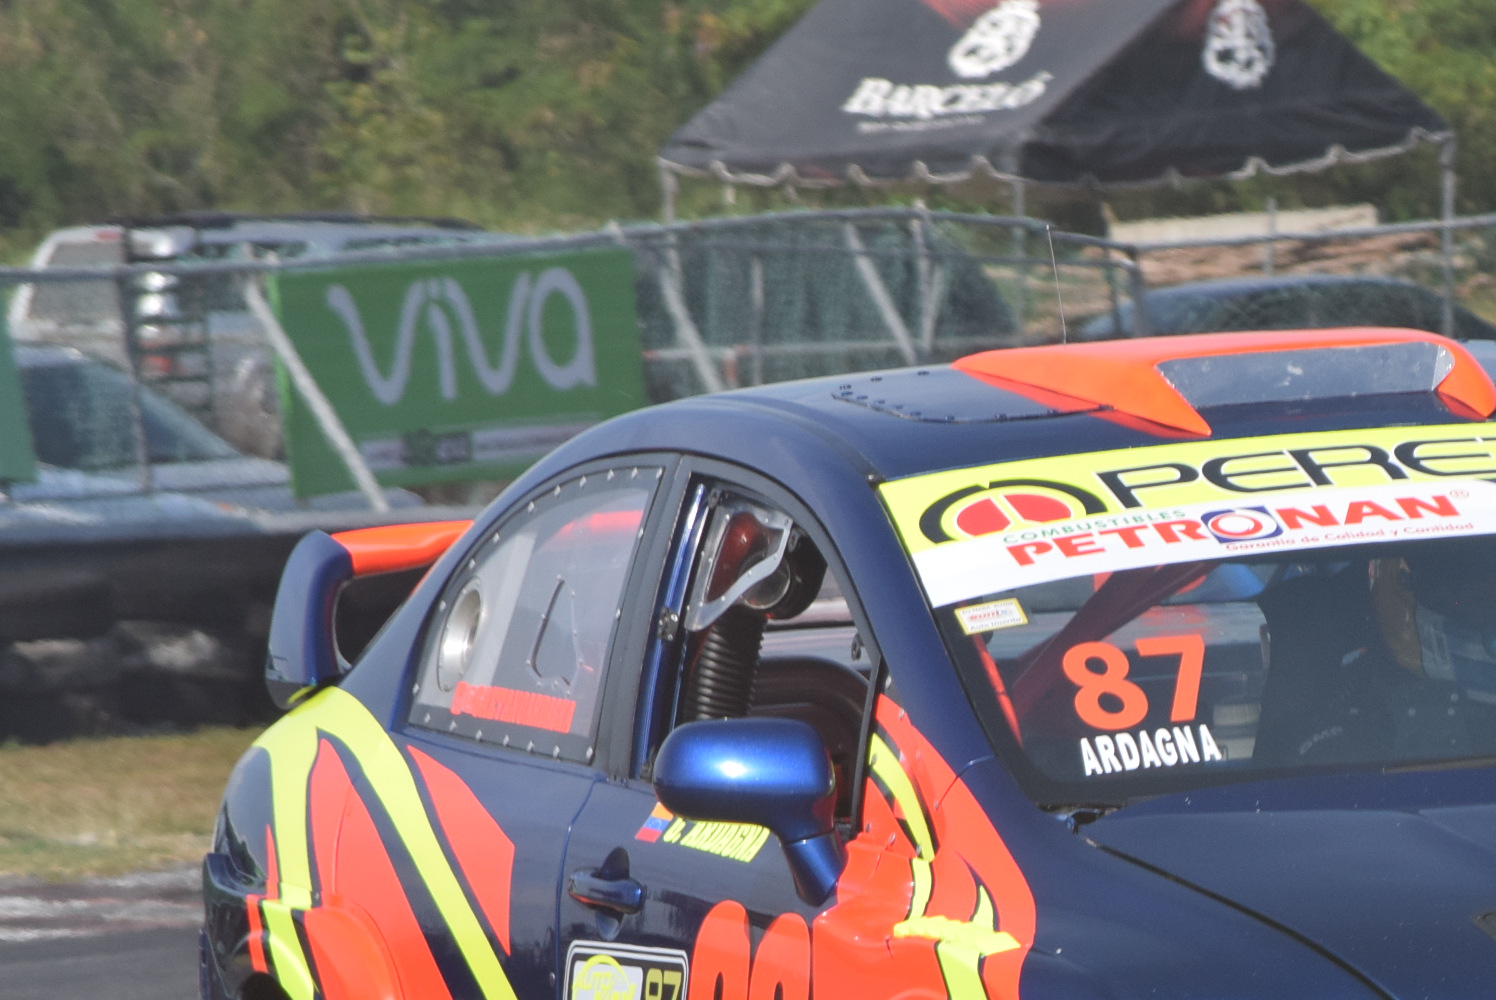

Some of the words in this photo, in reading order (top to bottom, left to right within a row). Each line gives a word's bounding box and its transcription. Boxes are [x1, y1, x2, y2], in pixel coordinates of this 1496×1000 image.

[1003, 508, 1186, 544] COMBUSTIBLES
[1325, 528, 1384, 540] Calidad
[1403, 522, 1474, 534] Cantidad
[1062, 634, 1206, 731] 87
[1080, 723, 1223, 776] ARDAGNA
